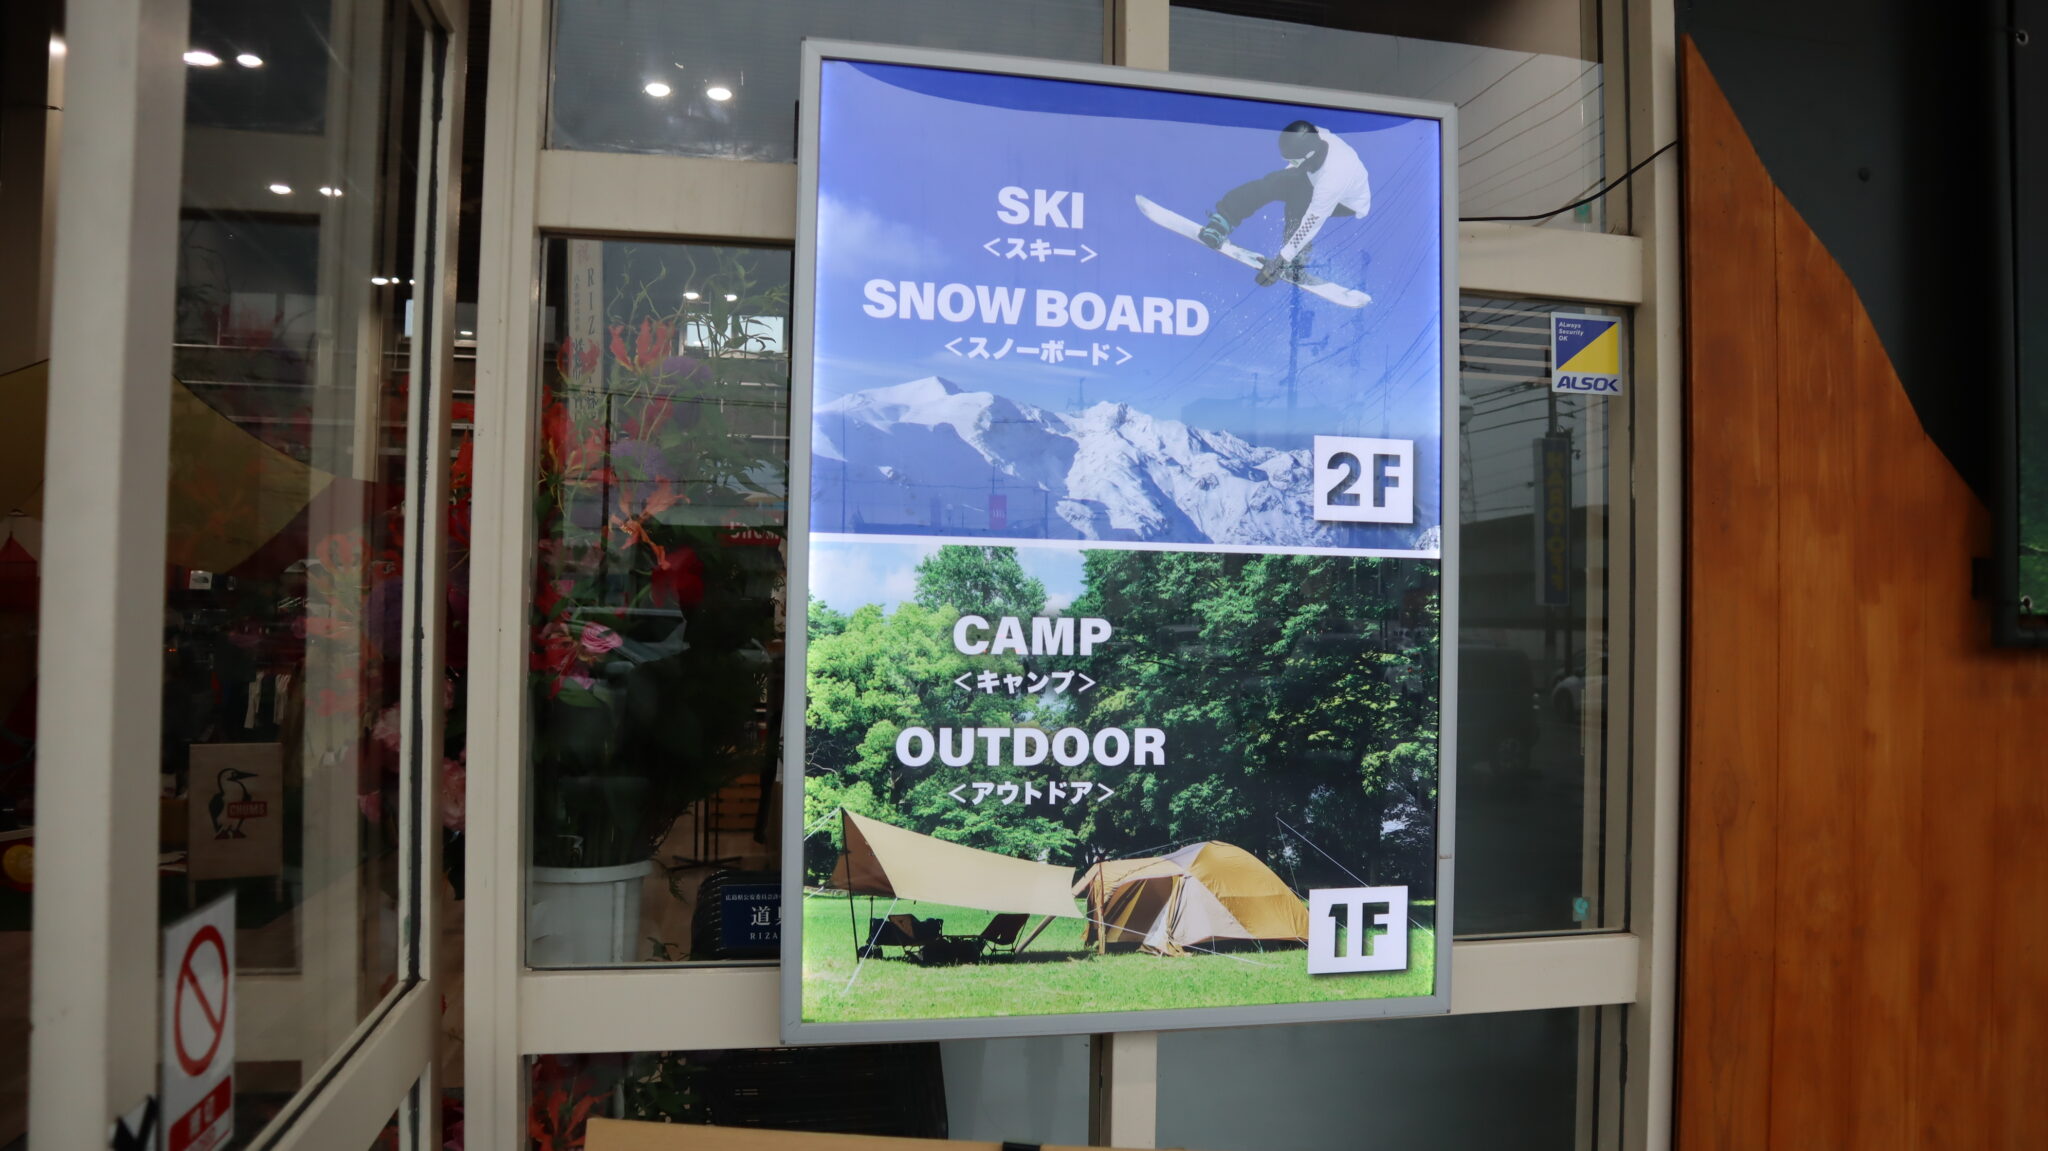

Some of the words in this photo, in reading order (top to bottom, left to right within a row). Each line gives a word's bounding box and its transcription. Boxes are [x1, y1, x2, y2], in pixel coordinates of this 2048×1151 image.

[997, 186, 1084, 229] SKI
[863, 279, 1026, 325] SNOW
[1036, 289, 1209, 337] BOARD
[1558, 328, 1585, 337] Security
[1557, 376, 1619, 392] ALSOK
[1326, 451, 1401, 508] 2F
[954, 615, 1112, 655] CAMP
[896, 727, 1165, 767] OUTDOOR
[1326, 899, 1392, 959] 1F
